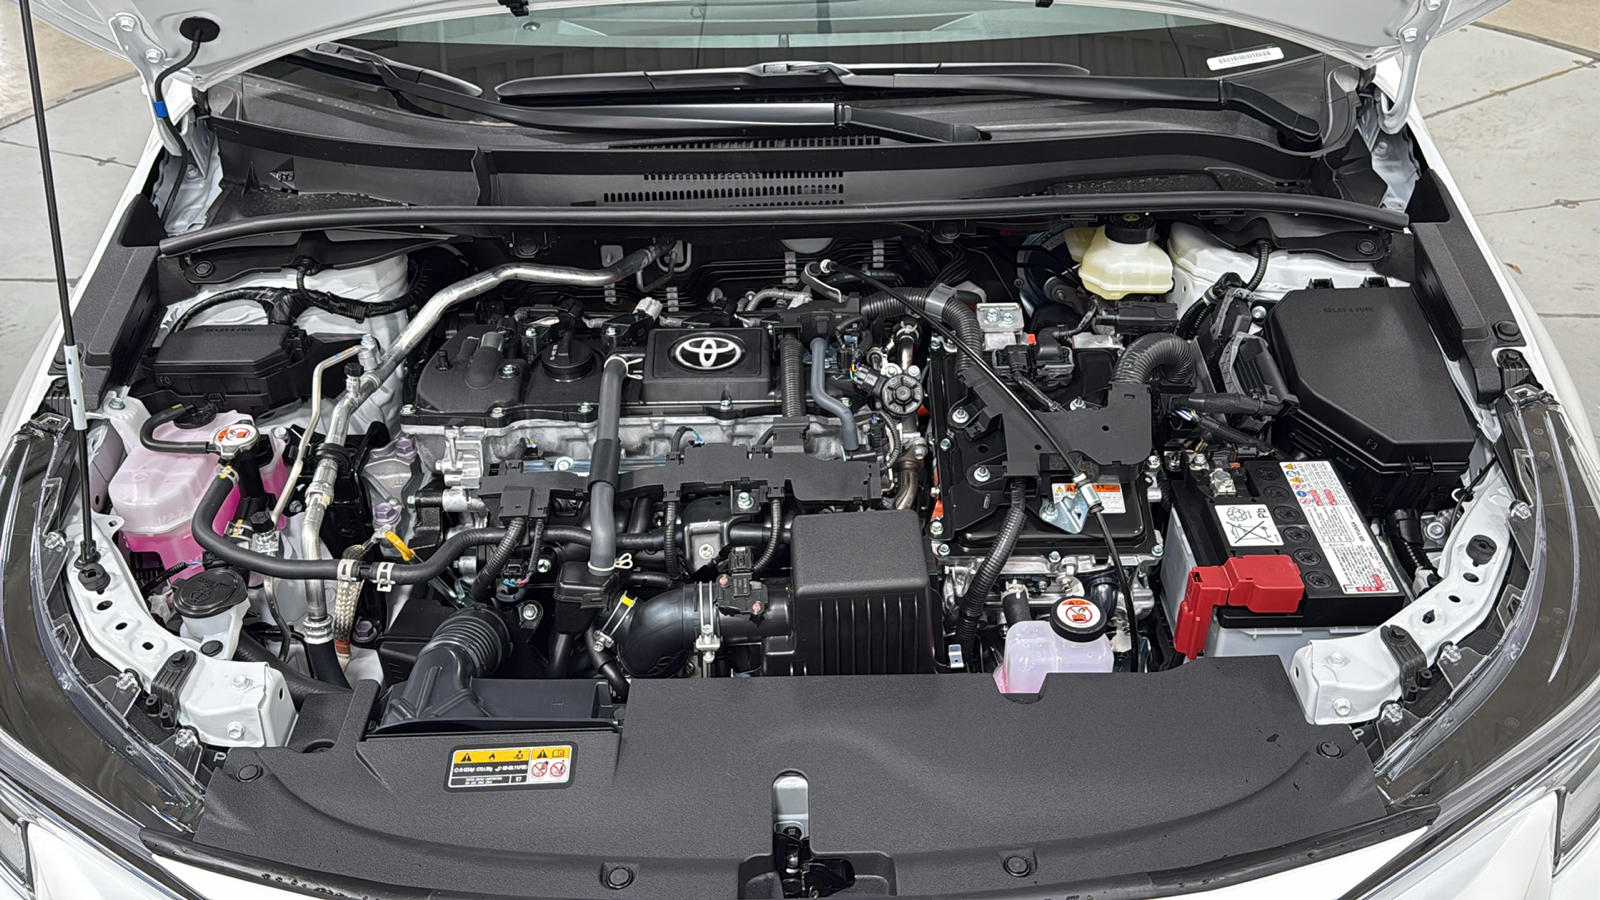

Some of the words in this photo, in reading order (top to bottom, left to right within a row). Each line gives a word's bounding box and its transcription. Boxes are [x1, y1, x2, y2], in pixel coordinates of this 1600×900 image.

[1365, 438, 1378, 450] F3
[158, 506, 187, 525] MAX
[1257, 507, 1269, 519] Pb
